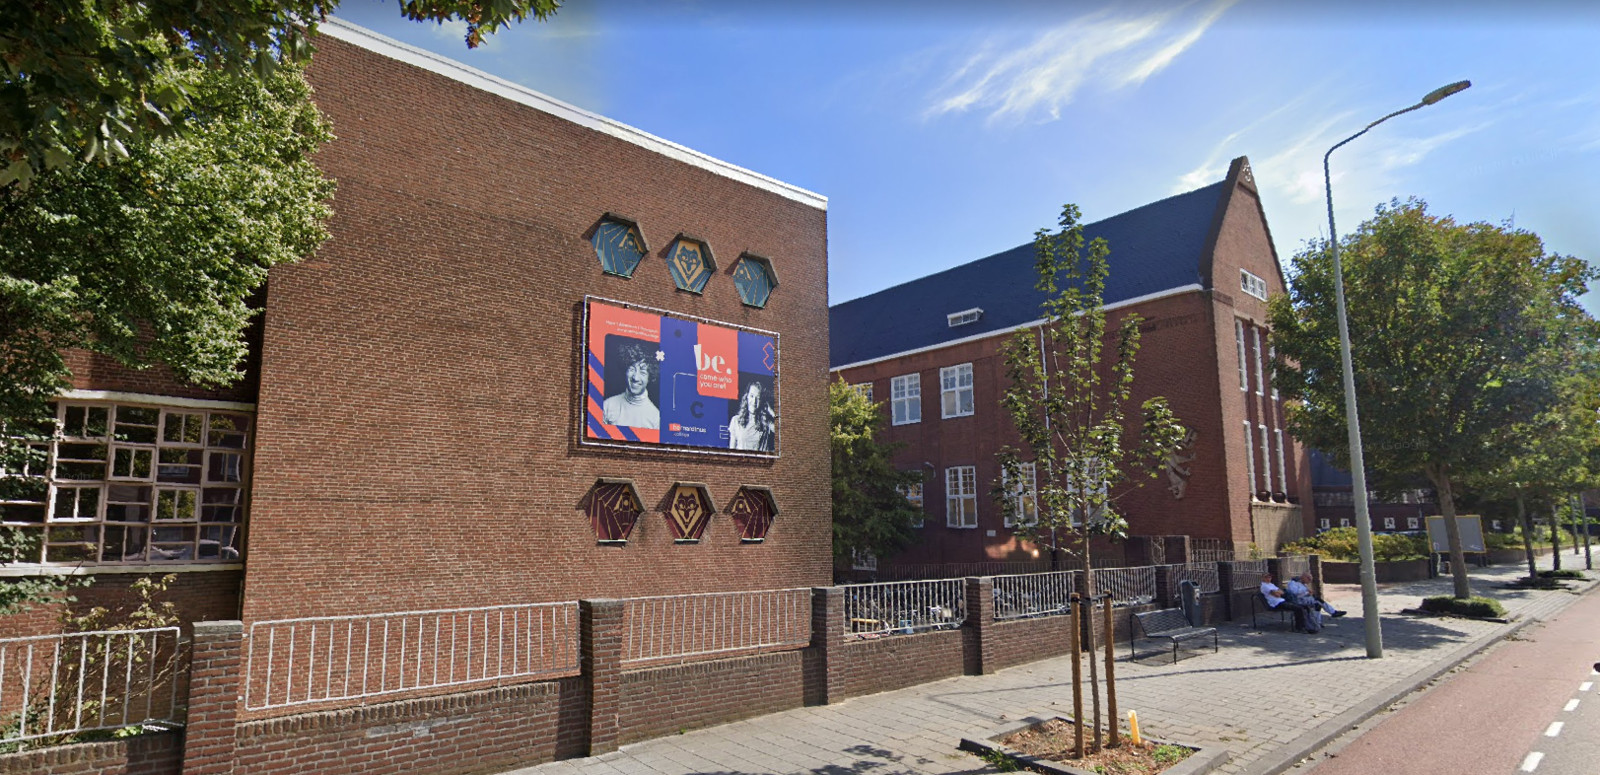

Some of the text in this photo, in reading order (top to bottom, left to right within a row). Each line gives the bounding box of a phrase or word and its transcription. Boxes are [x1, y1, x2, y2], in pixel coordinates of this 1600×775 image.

[693, 343, 732, 375] be.
[699, 374, 733, 384] come who
[699, 380, 726, 390] you are!
